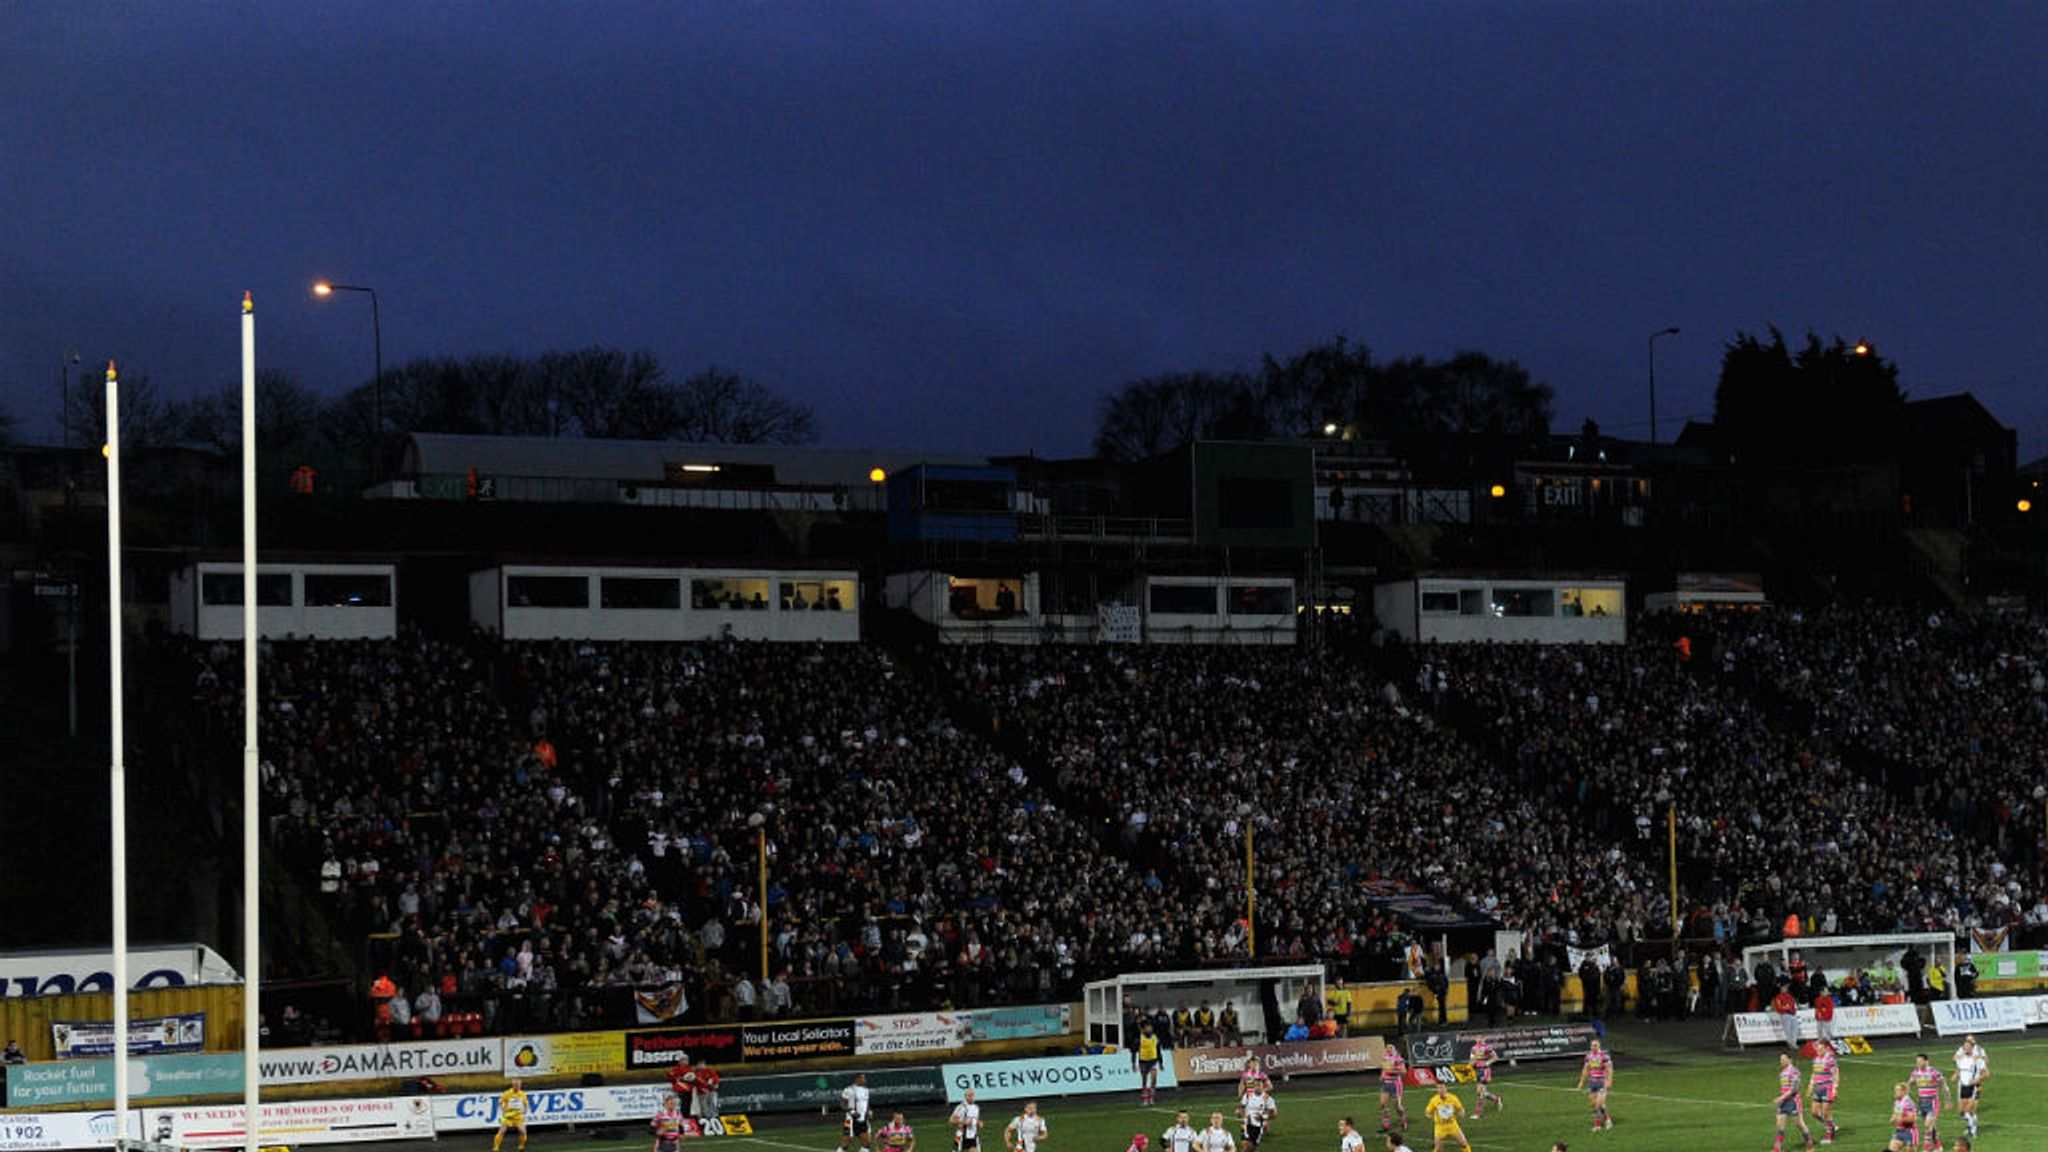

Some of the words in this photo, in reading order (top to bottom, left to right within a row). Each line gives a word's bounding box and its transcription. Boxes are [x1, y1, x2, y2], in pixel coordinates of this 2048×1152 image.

[1544, 486, 1577, 505] EXIT
[1945, 1001, 1987, 1020] MDH
[891, 1018, 922, 1030] STOP
[633, 1032, 735, 1050] Petherbridge
[744, 1032, 769, 1044] Your
[772, 1030, 799, 1042] Local
[802, 1027, 850, 1041] Solicitors
[259, 1047, 493, 1078] www.DAMART.co.uk
[23, 1068, 67, 1081] Rocket
[70, 1067, 96, 1079] fuel
[156, 1069, 202, 1081] Bradford
[956, 1065, 1103, 1090] GREENWOODS
[1436, 1066, 1456, 1083] 40
[13, 1084, 31, 1097] for
[35, 1085, 62, 1099] your
[67, 1081, 107, 1094] future
[700, 1116, 725, 1136] 20
